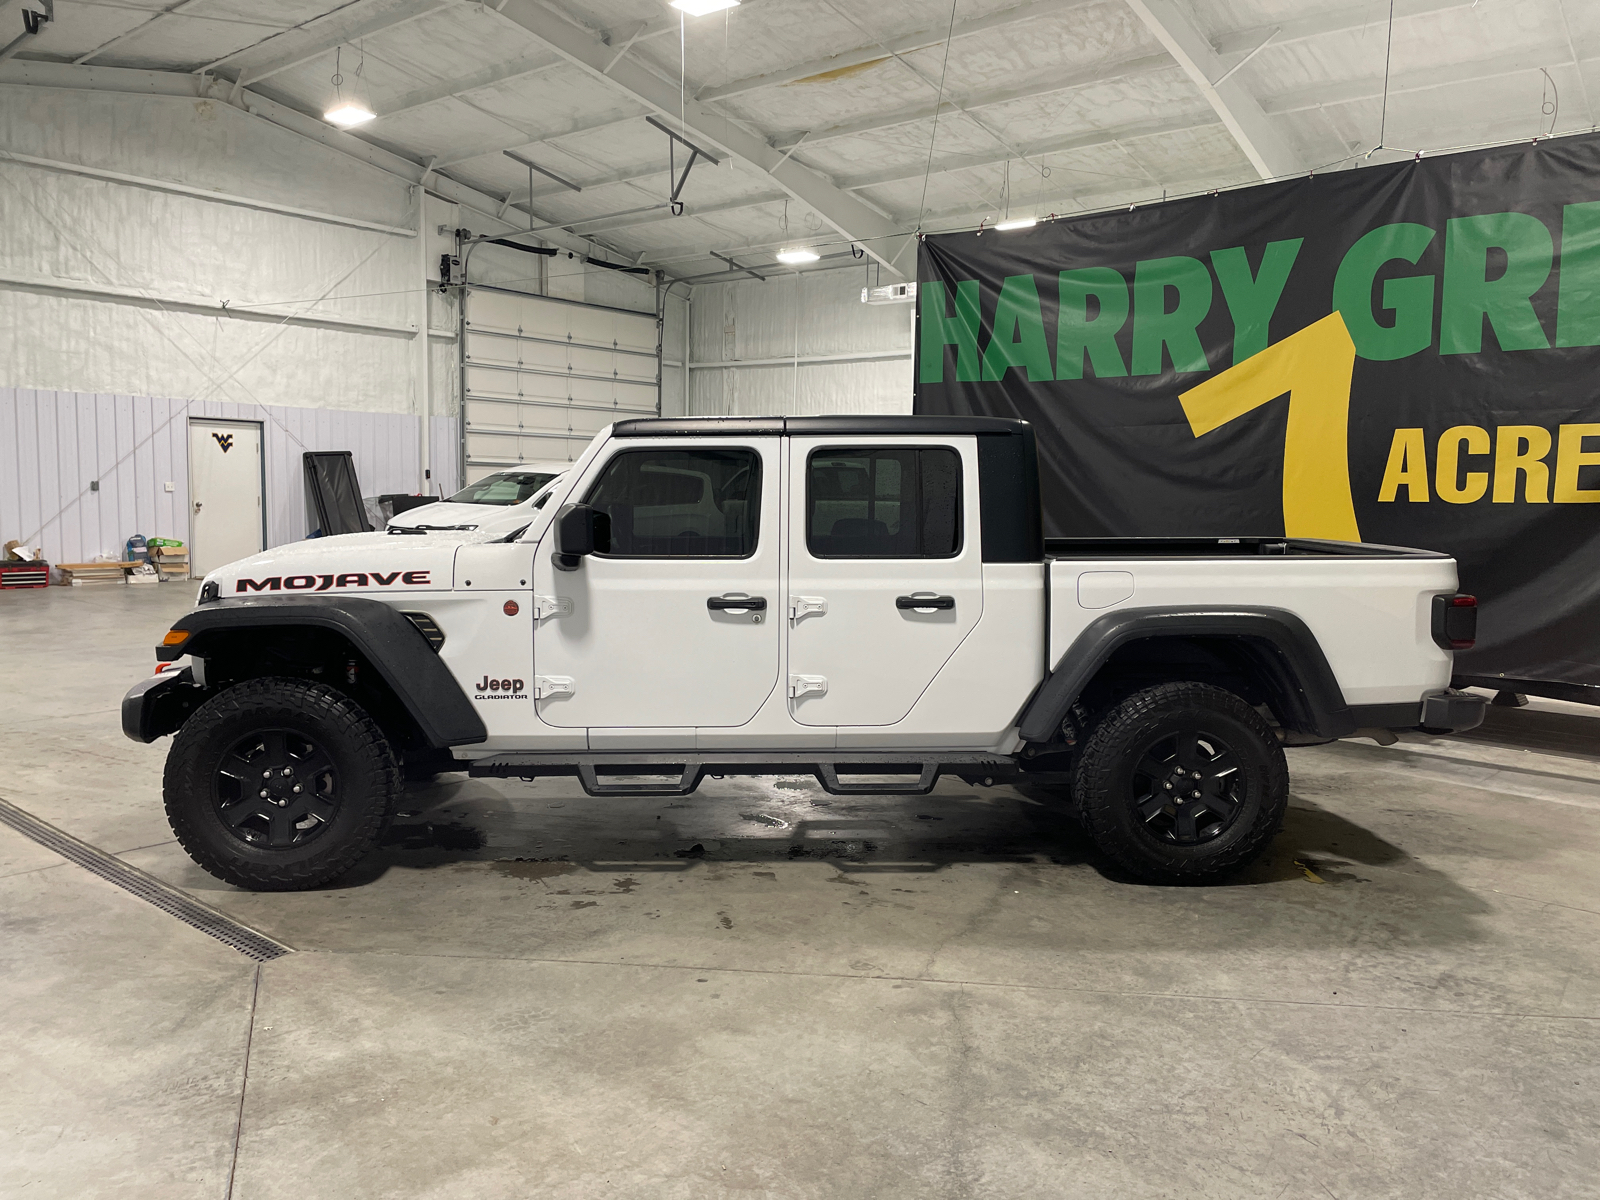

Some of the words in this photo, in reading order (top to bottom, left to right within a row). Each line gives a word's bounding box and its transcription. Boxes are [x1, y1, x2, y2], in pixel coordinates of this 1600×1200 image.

[919, 237, 1304, 383] HARRY
[1378, 423, 1600, 504] ACRE
[236, 570, 431, 593] MOJAVE
[475, 675, 525, 694] Jeep
